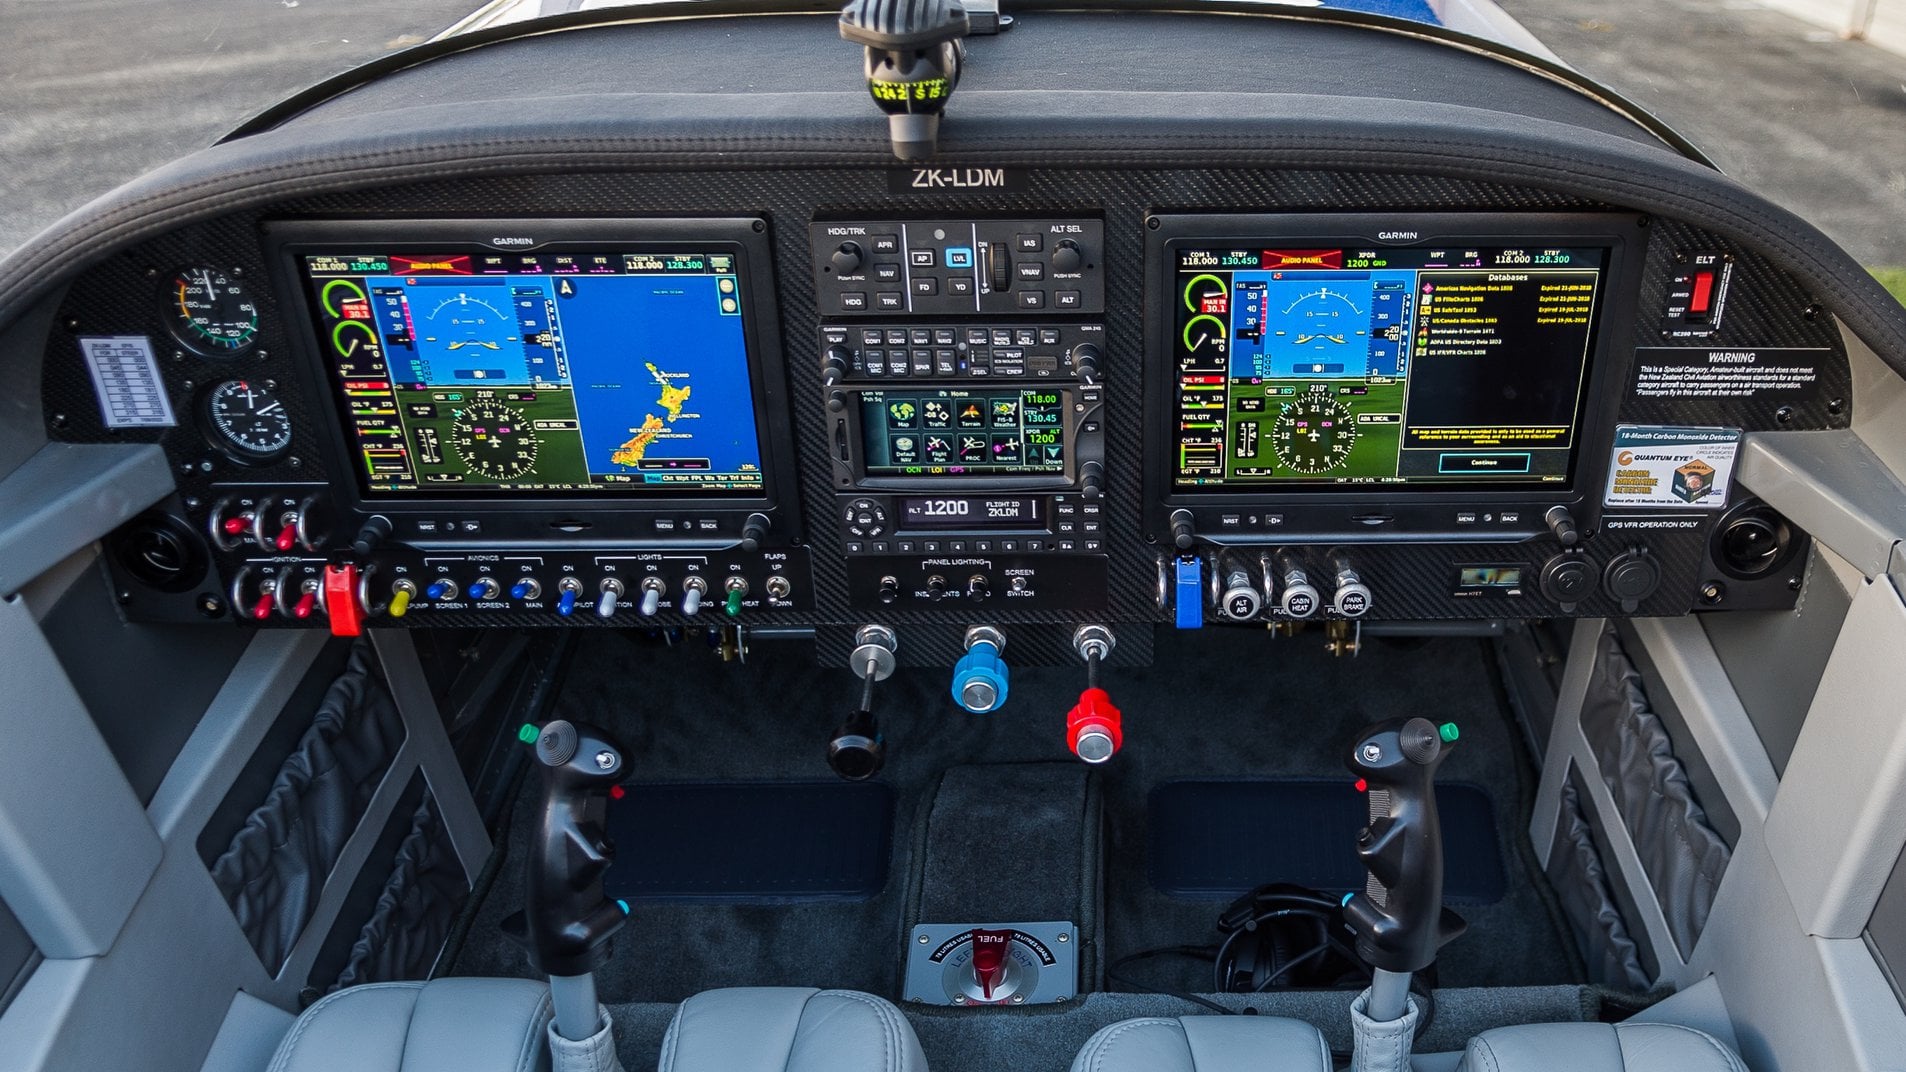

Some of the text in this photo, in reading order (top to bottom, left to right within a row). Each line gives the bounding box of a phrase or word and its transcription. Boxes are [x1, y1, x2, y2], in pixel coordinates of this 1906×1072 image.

[912, 168, 1004, 188] ZK-LDM
[828, 228, 866, 236] HDG/TRK
[878, 240, 893, 249] APR
[1024, 240, 1036, 248] IAS
[917, 254, 928, 262] AP
[953, 254, 966, 262] LVL
[1222, 257, 1258, 265] 130.450
[1534, 256, 1570, 264] 128.300
[1696, 256, 1716, 264] ELT
[626, 261, 663, 269] 118.000
[1347, 260, 1368, 268] 1200
[879, 270, 894, 278] NAV
[1021, 268, 1040, 276] VNAV
[845, 298, 862, 306] HDG
[1062, 296, 1074, 304] ALT
[1708, 352, 1756, 362] WARNING
[1028, 396, 1056, 404] 118.00
[1028, 414, 1056, 422] 130.45
[1030, 434, 1056, 444] 1200
[924, 500, 968, 516] 1200
[988, 508, 1018, 517] ZKLDM
[942, 940, 958, 956] LITRES
[1020, 934, 1051, 962] LITRES USABLE
